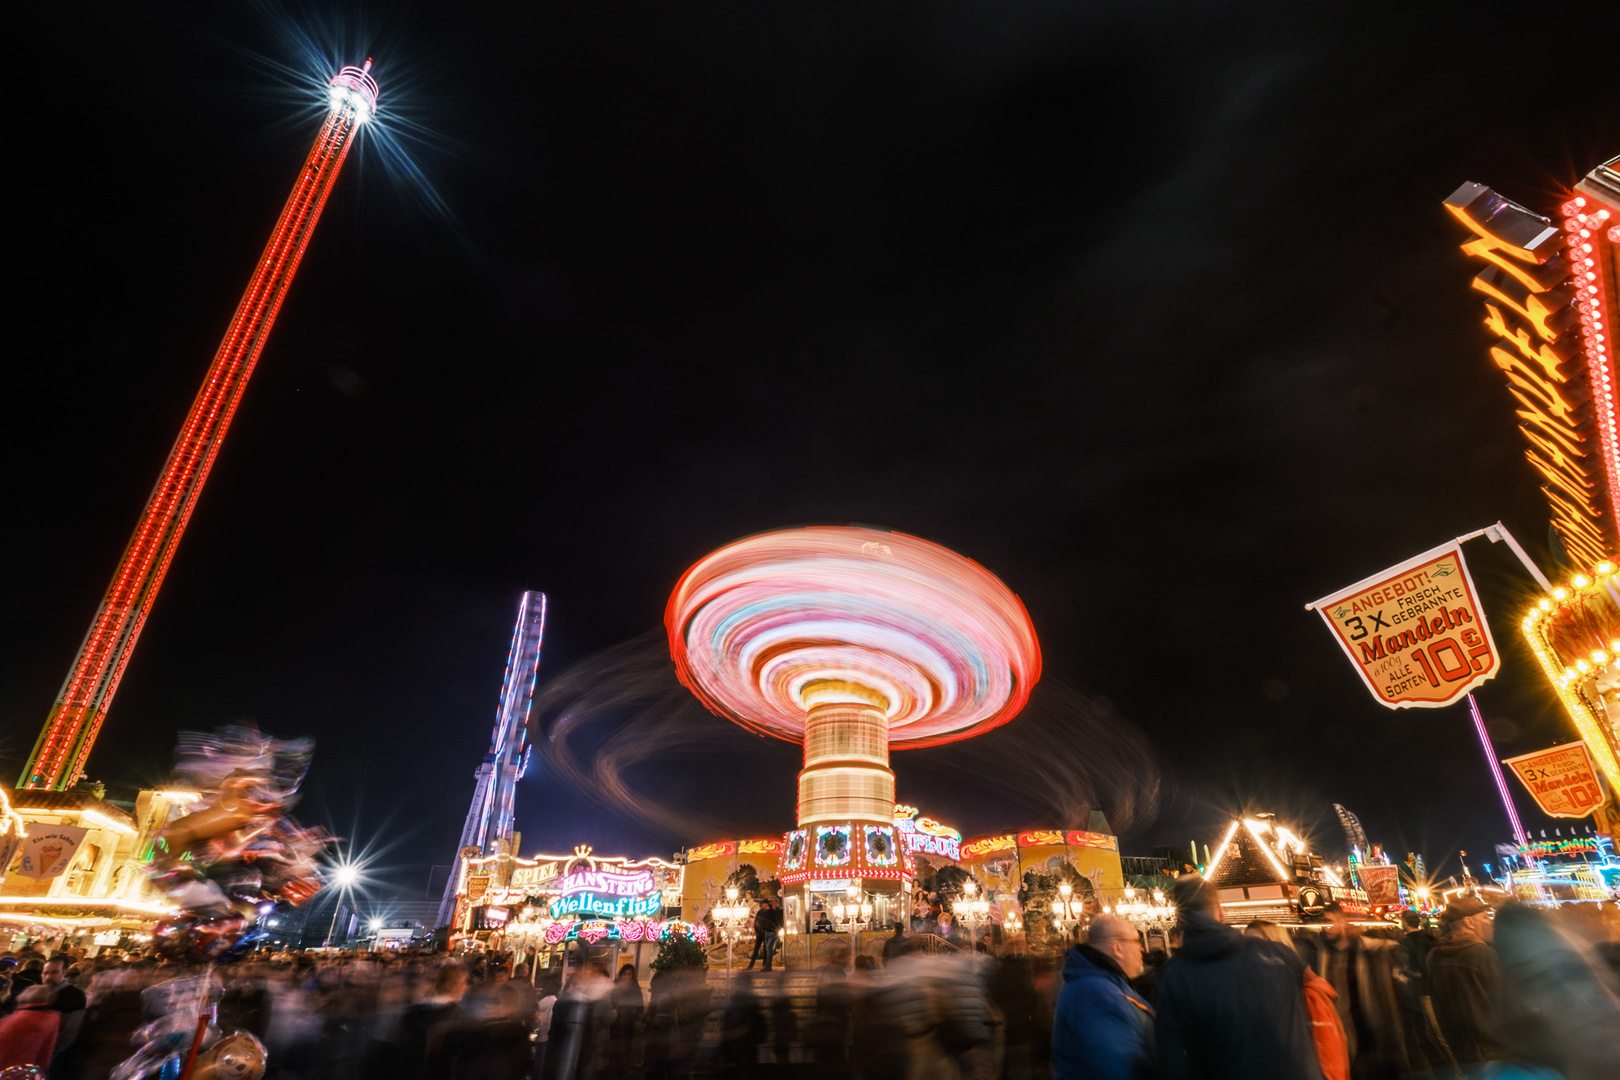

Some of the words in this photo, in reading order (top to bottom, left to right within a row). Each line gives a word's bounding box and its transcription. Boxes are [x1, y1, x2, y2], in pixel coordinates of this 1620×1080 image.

[1352, 572, 1432, 614] ANGEBOT!
[1397, 586, 1440, 608] FRISCH
[1344, 616, 1368, 641] 3
[1392, 588, 1463, 625] GEBRANNTE
[1358, 606, 1472, 665] Mandeln
[1385, 672, 1427, 698] SORTEN
[1389, 664, 1412, 684] ALLE
[1528, 753, 1570, 769] ANGEBOT!
[1525, 769, 1537, 781] 3
[1533, 771, 1592, 794] Mandeln
[1549, 802, 1570, 811] SORTEN
[513, 862, 558, 886] SPIEL
[1361, 869, 1396, 890] Pommes
[551, 892, 661, 919] Wellenflug
